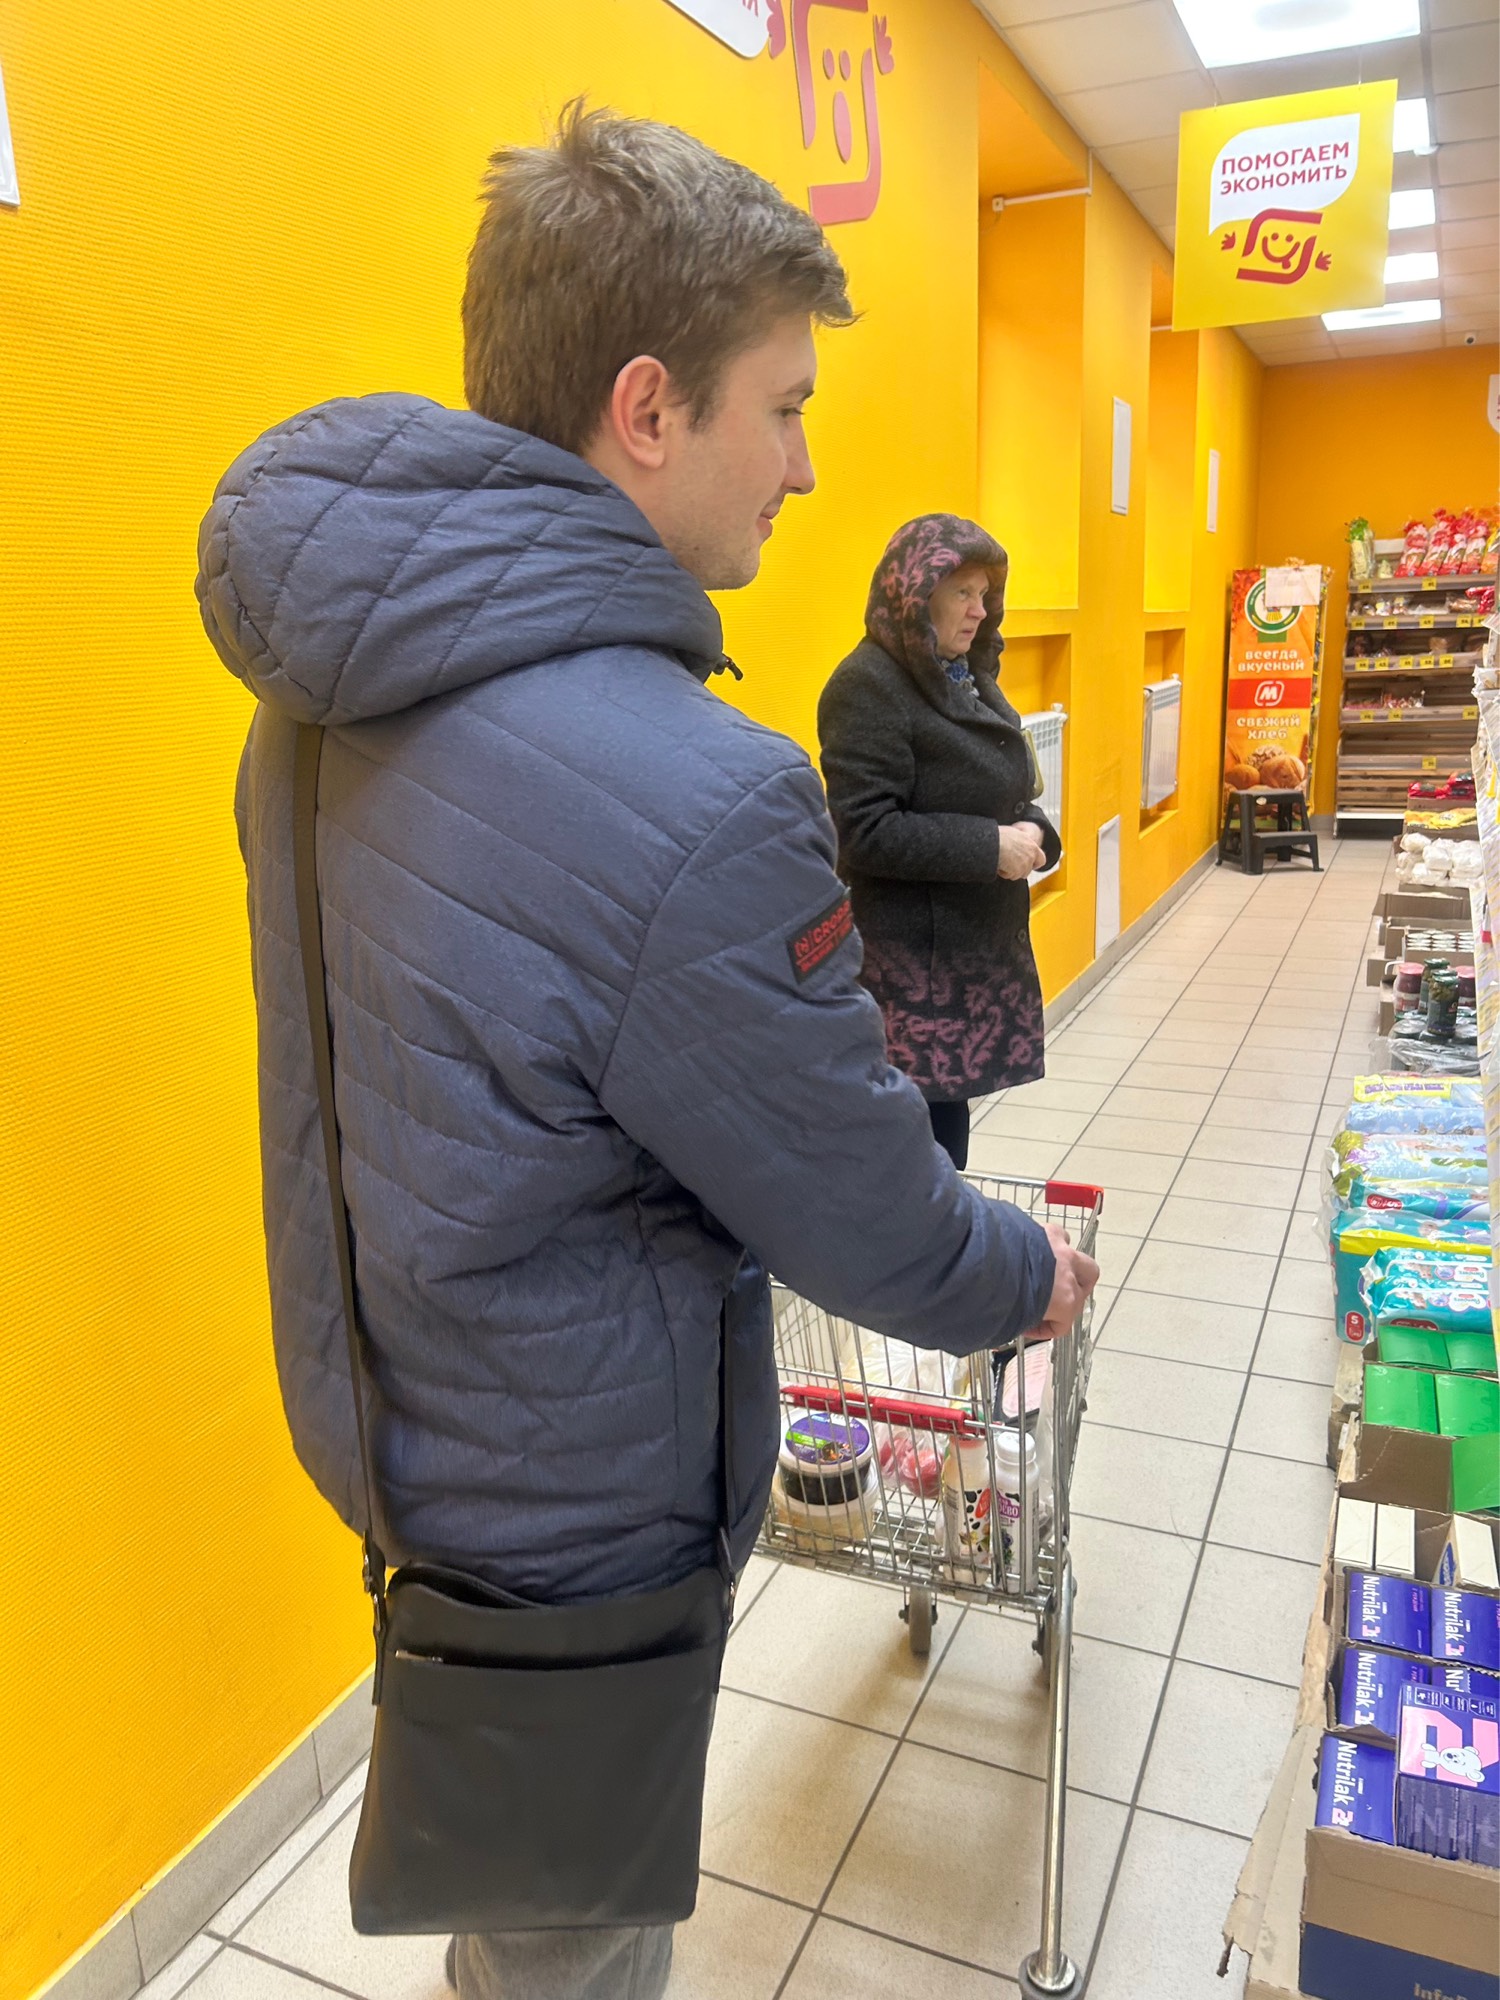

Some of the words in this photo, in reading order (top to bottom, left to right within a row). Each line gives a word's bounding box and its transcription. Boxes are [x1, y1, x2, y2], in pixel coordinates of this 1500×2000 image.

[1220, 164, 1348, 195] ЭКОНОМИТЬ
[1221, 141, 1350, 175] ПОМОГАЕМ
[1361, 1575, 1381, 1623] Nutrilak
[1444, 1592, 1465, 1642] Nutrilak
[1355, 1652, 1377, 1708] Nutrilak
[1333, 1740, 1358, 1806] Nutrilak
